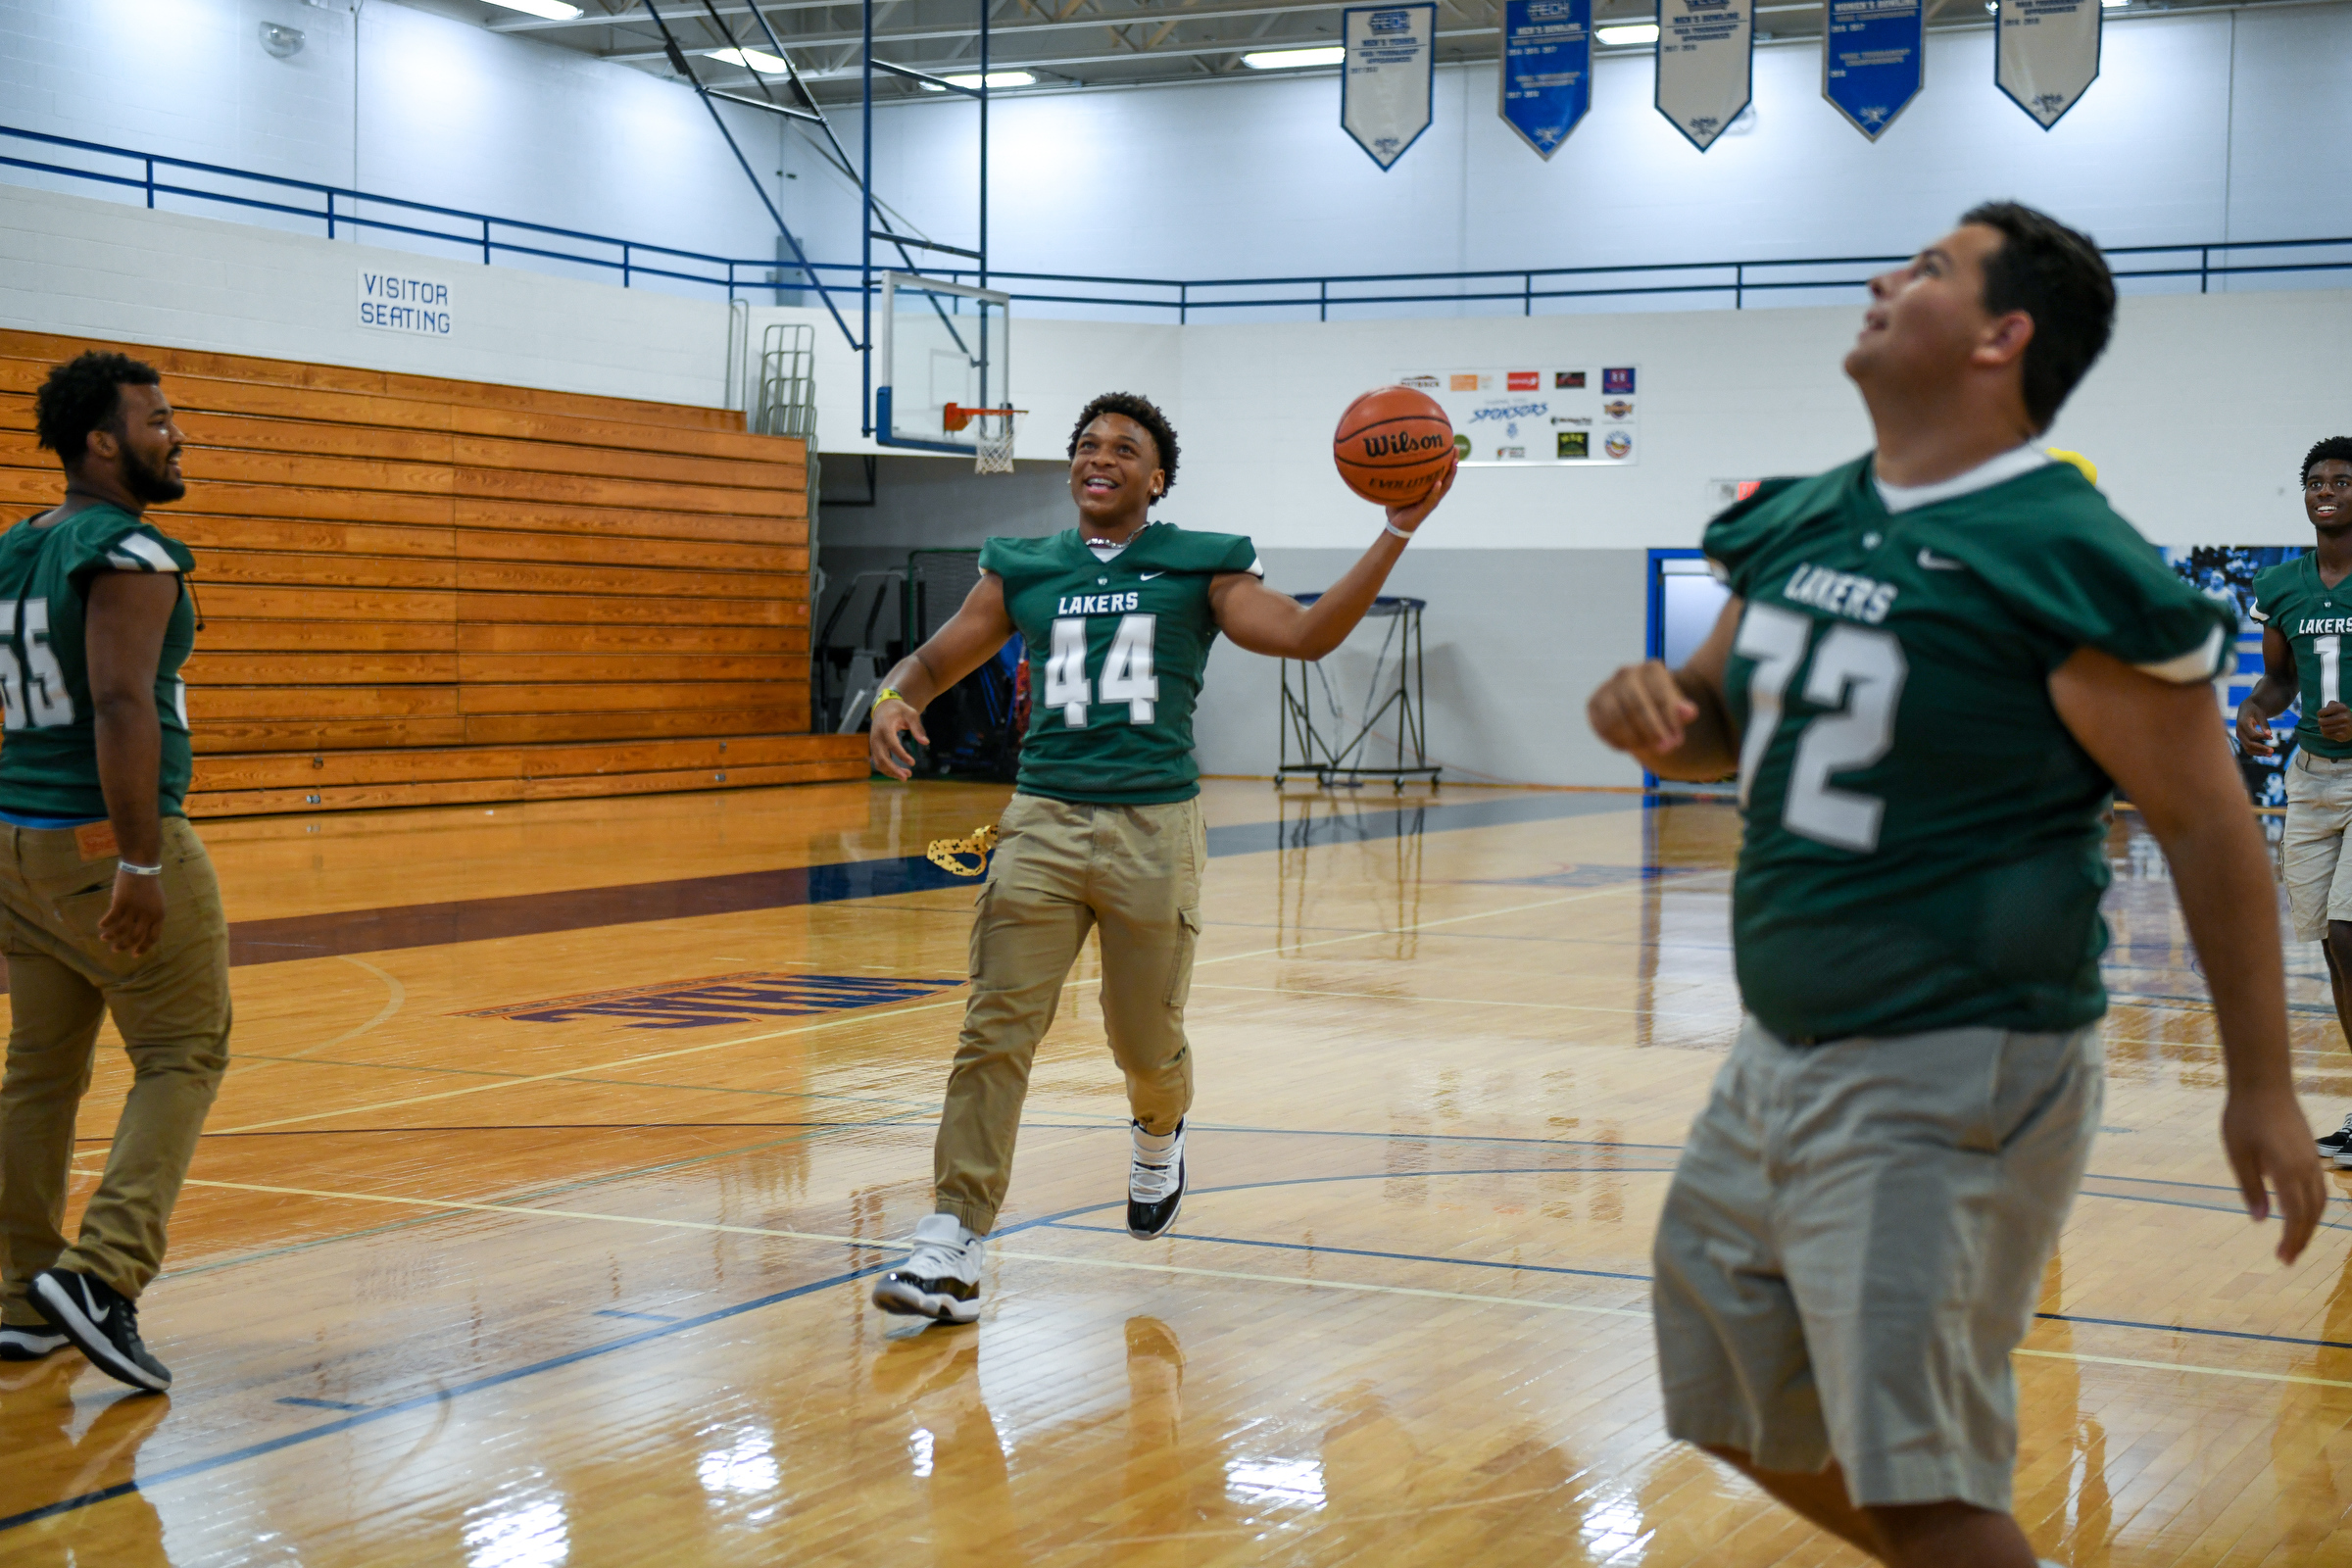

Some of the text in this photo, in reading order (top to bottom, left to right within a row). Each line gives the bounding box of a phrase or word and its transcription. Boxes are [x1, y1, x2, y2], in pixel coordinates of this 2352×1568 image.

[364, 273, 448, 306] VISITOR
[361, 302, 450, 334] SEATING
[1473, 402, 1548, 422] SPONSORS
[1363, 431, 1444, 458] Wilson
[1058, 592, 1139, 614] LAKERS
[1784, 563, 1899, 624] LAKERS
[1045, 612, 1159, 728] 44
[2314, 634, 2341, 709] 1
[1738, 600, 1910, 855] 72
